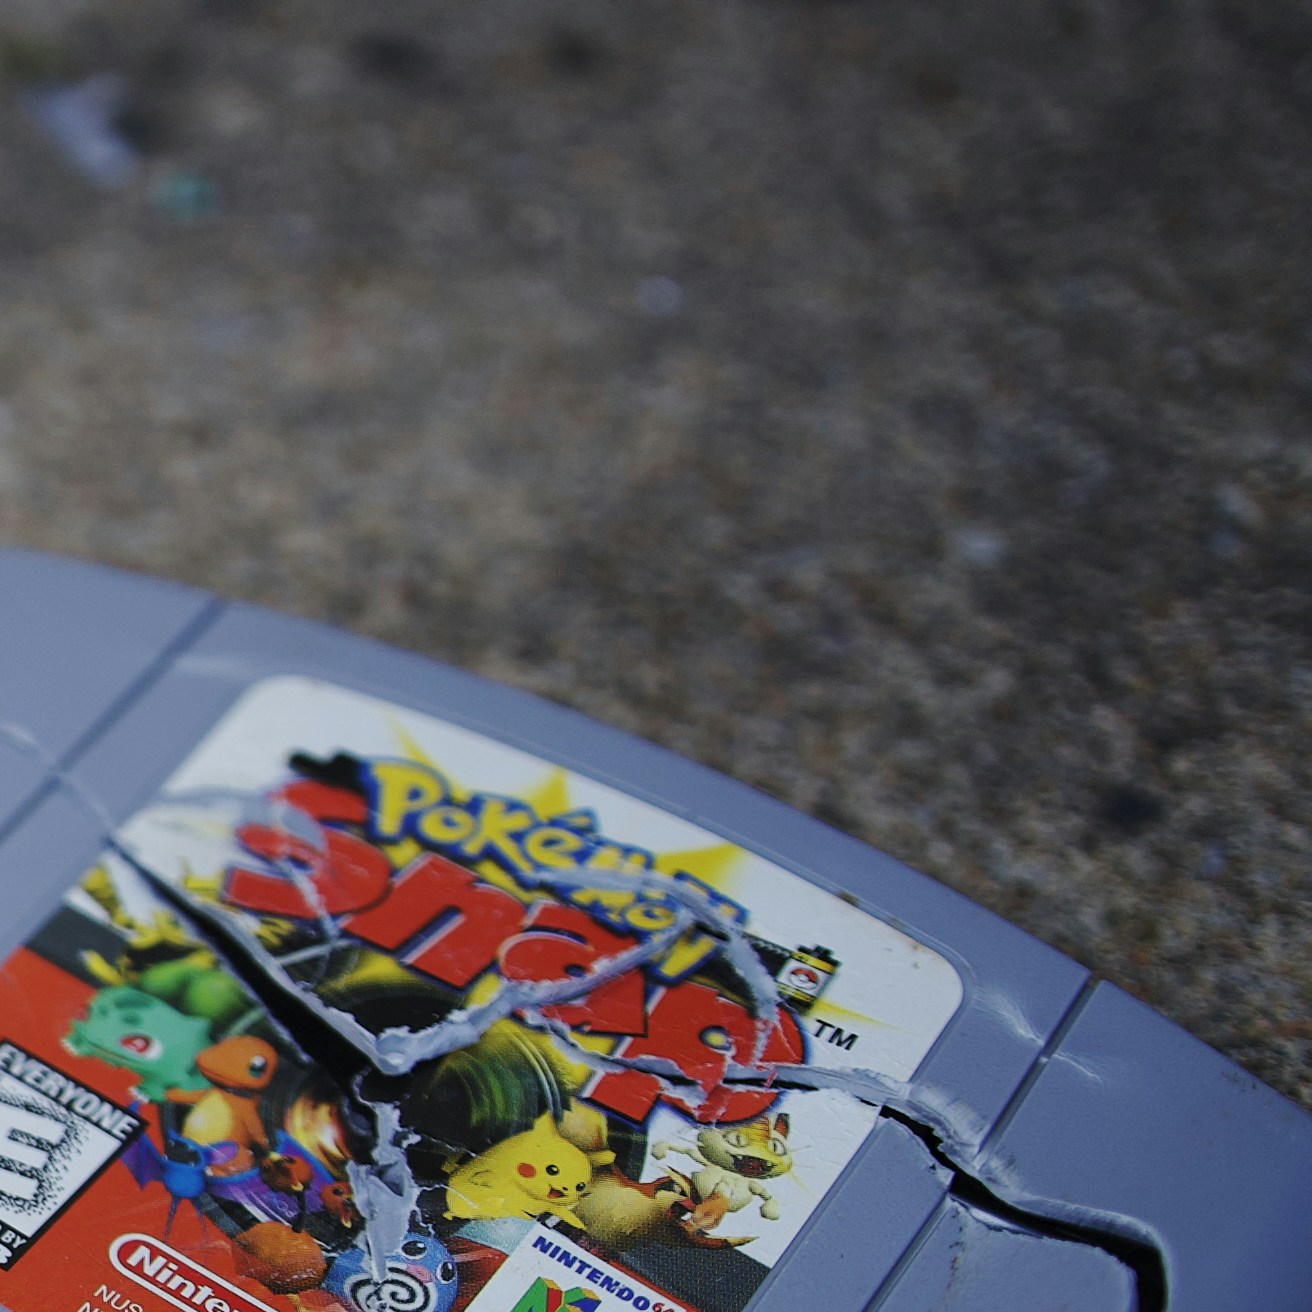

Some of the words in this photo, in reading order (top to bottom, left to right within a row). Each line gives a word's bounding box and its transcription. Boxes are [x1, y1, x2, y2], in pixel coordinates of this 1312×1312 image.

[812, 1018, 860, 1051] TM
[0, 1229, 27, 1250] BY
[532, 1235, 650, 1312] NINTENDO
